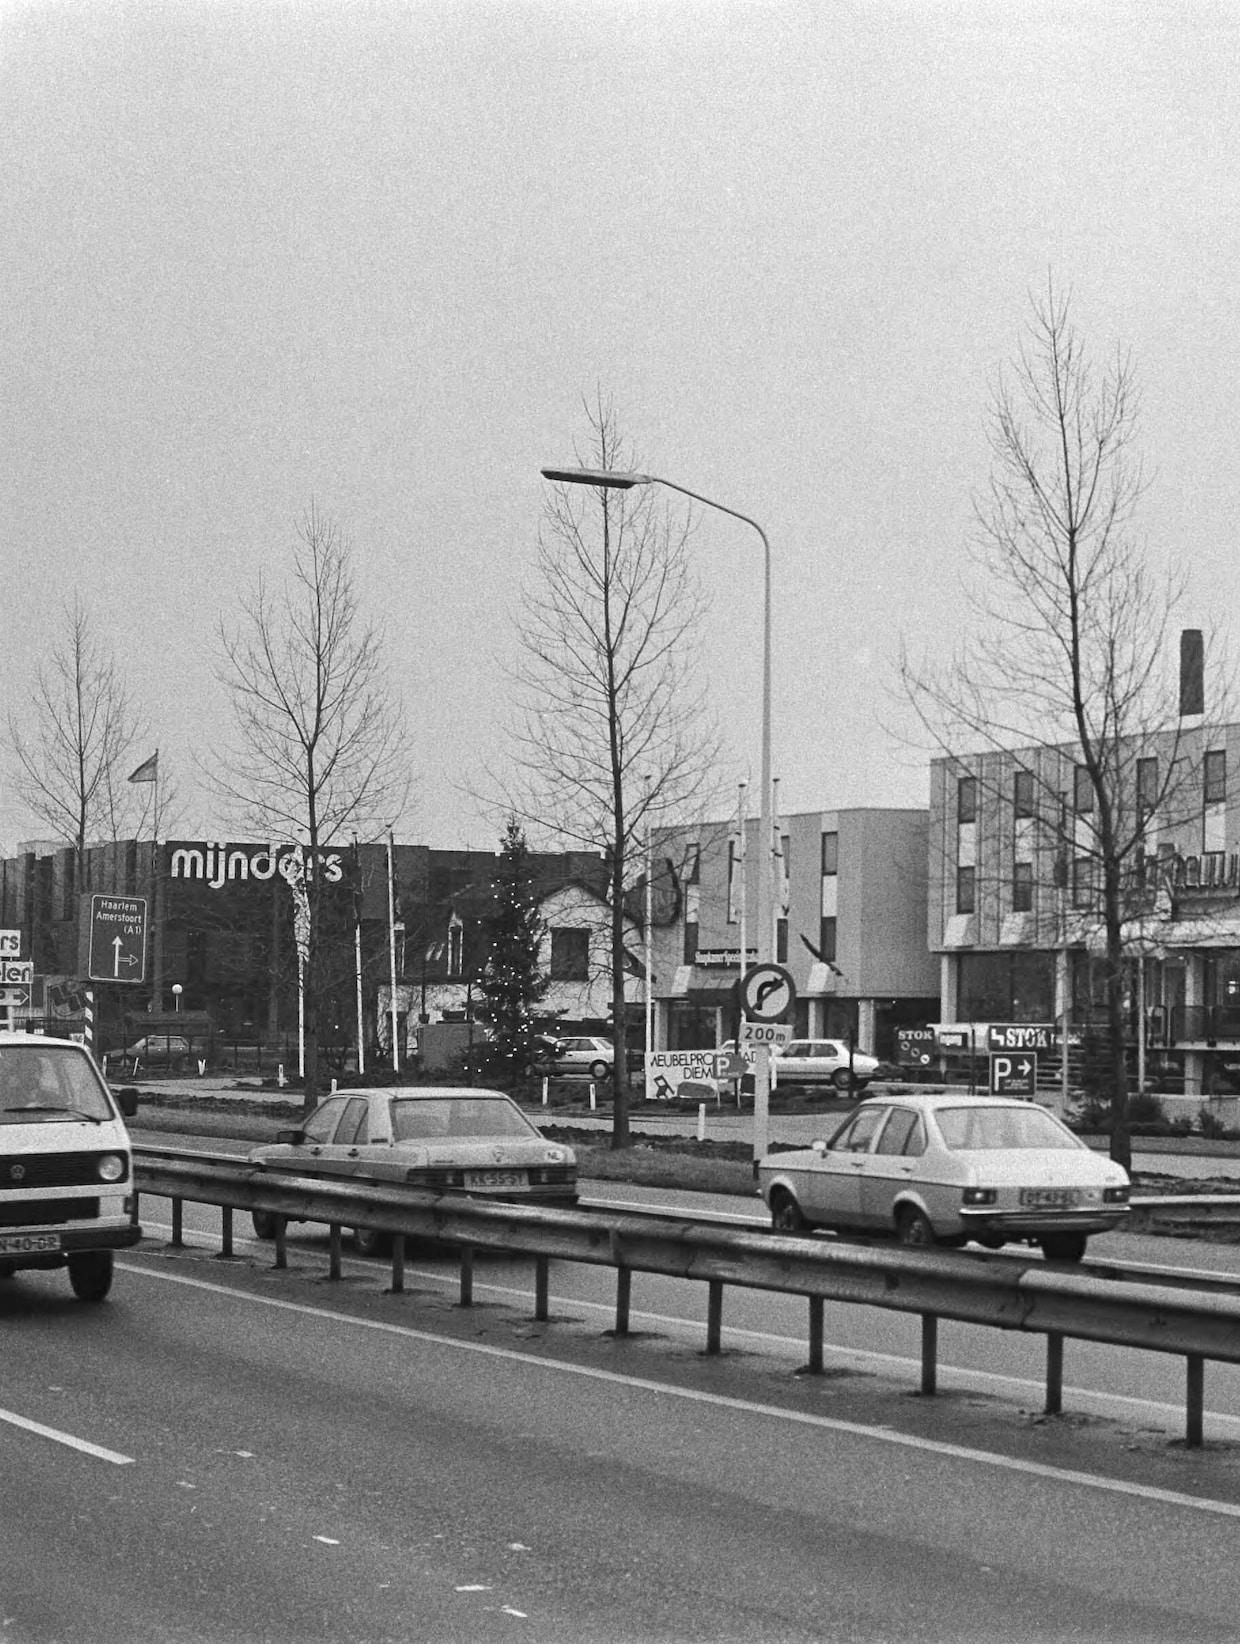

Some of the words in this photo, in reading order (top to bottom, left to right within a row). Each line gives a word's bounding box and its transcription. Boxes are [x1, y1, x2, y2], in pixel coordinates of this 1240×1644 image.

[101, 900, 137, 912] Haarlem
[96, 911, 142, 923] Amersfoort
[898, 1030, 933, 1041] STOK
[1006, 1028, 1048, 1048] STOK
[717, 1056, 731, 1078] P
[994, 1057, 1013, 1092] P
